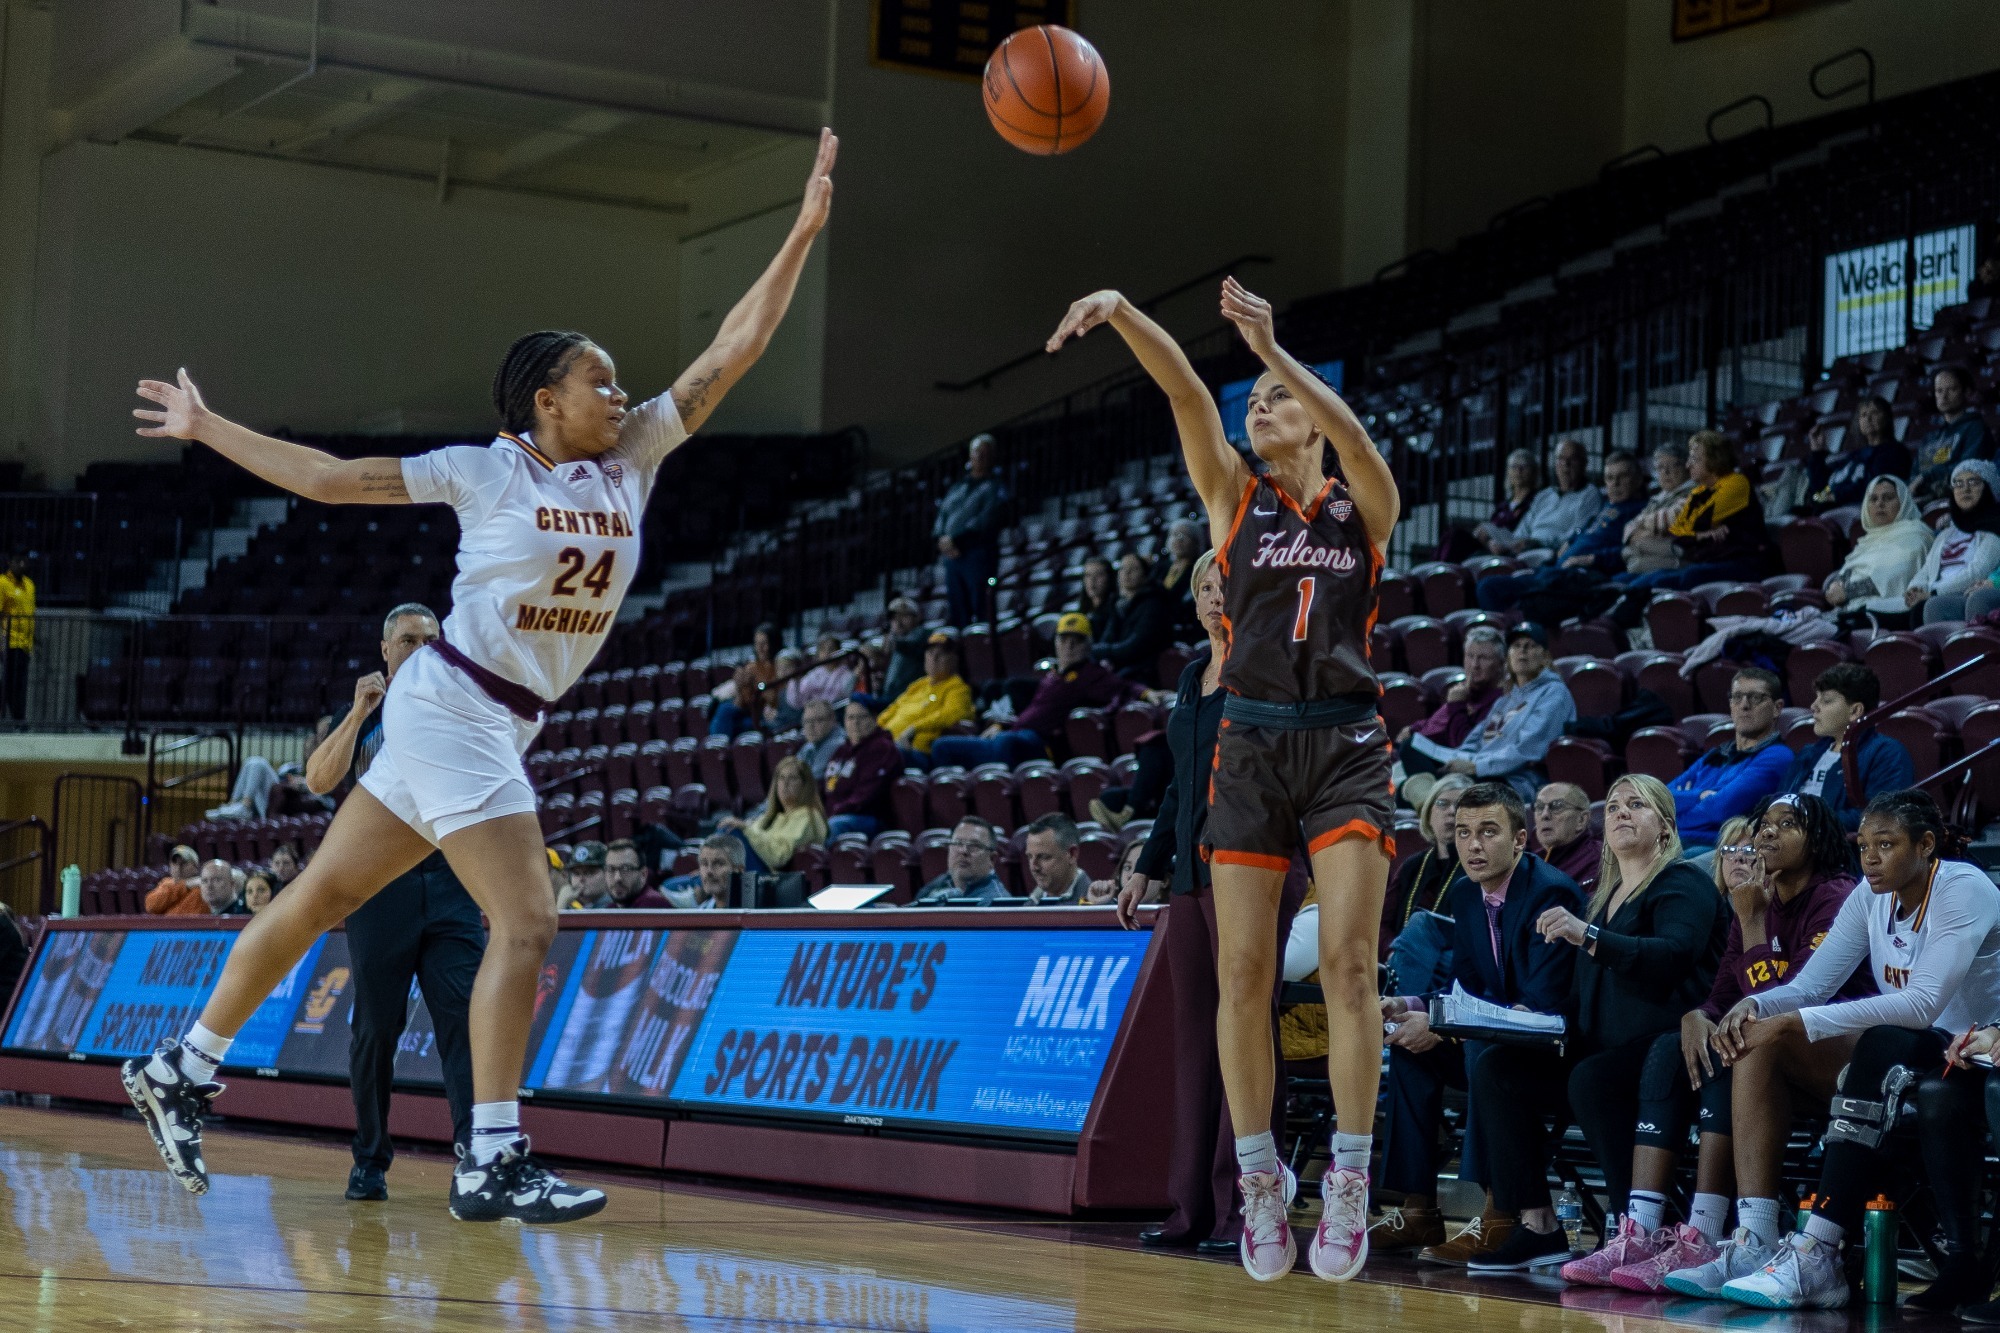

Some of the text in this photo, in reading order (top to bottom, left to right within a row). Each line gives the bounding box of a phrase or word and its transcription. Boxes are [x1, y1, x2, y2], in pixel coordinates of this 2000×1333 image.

[1838, 243, 1958, 296] Weicert
[535, 506, 634, 537] CENTRAL
[1329, 505, 1353, 515] MAC
[551, 546, 616, 599] 24
[1251, 528, 1357, 570] Falcons
[1292, 576, 1316, 643] 1
[775, 941, 947, 1012] NATURE'S
[1014, 955, 1131, 1030] MILK
[620, 1007, 691, 1090] MILK
[703, 1028, 959, 1113] SPORTS DRINK
